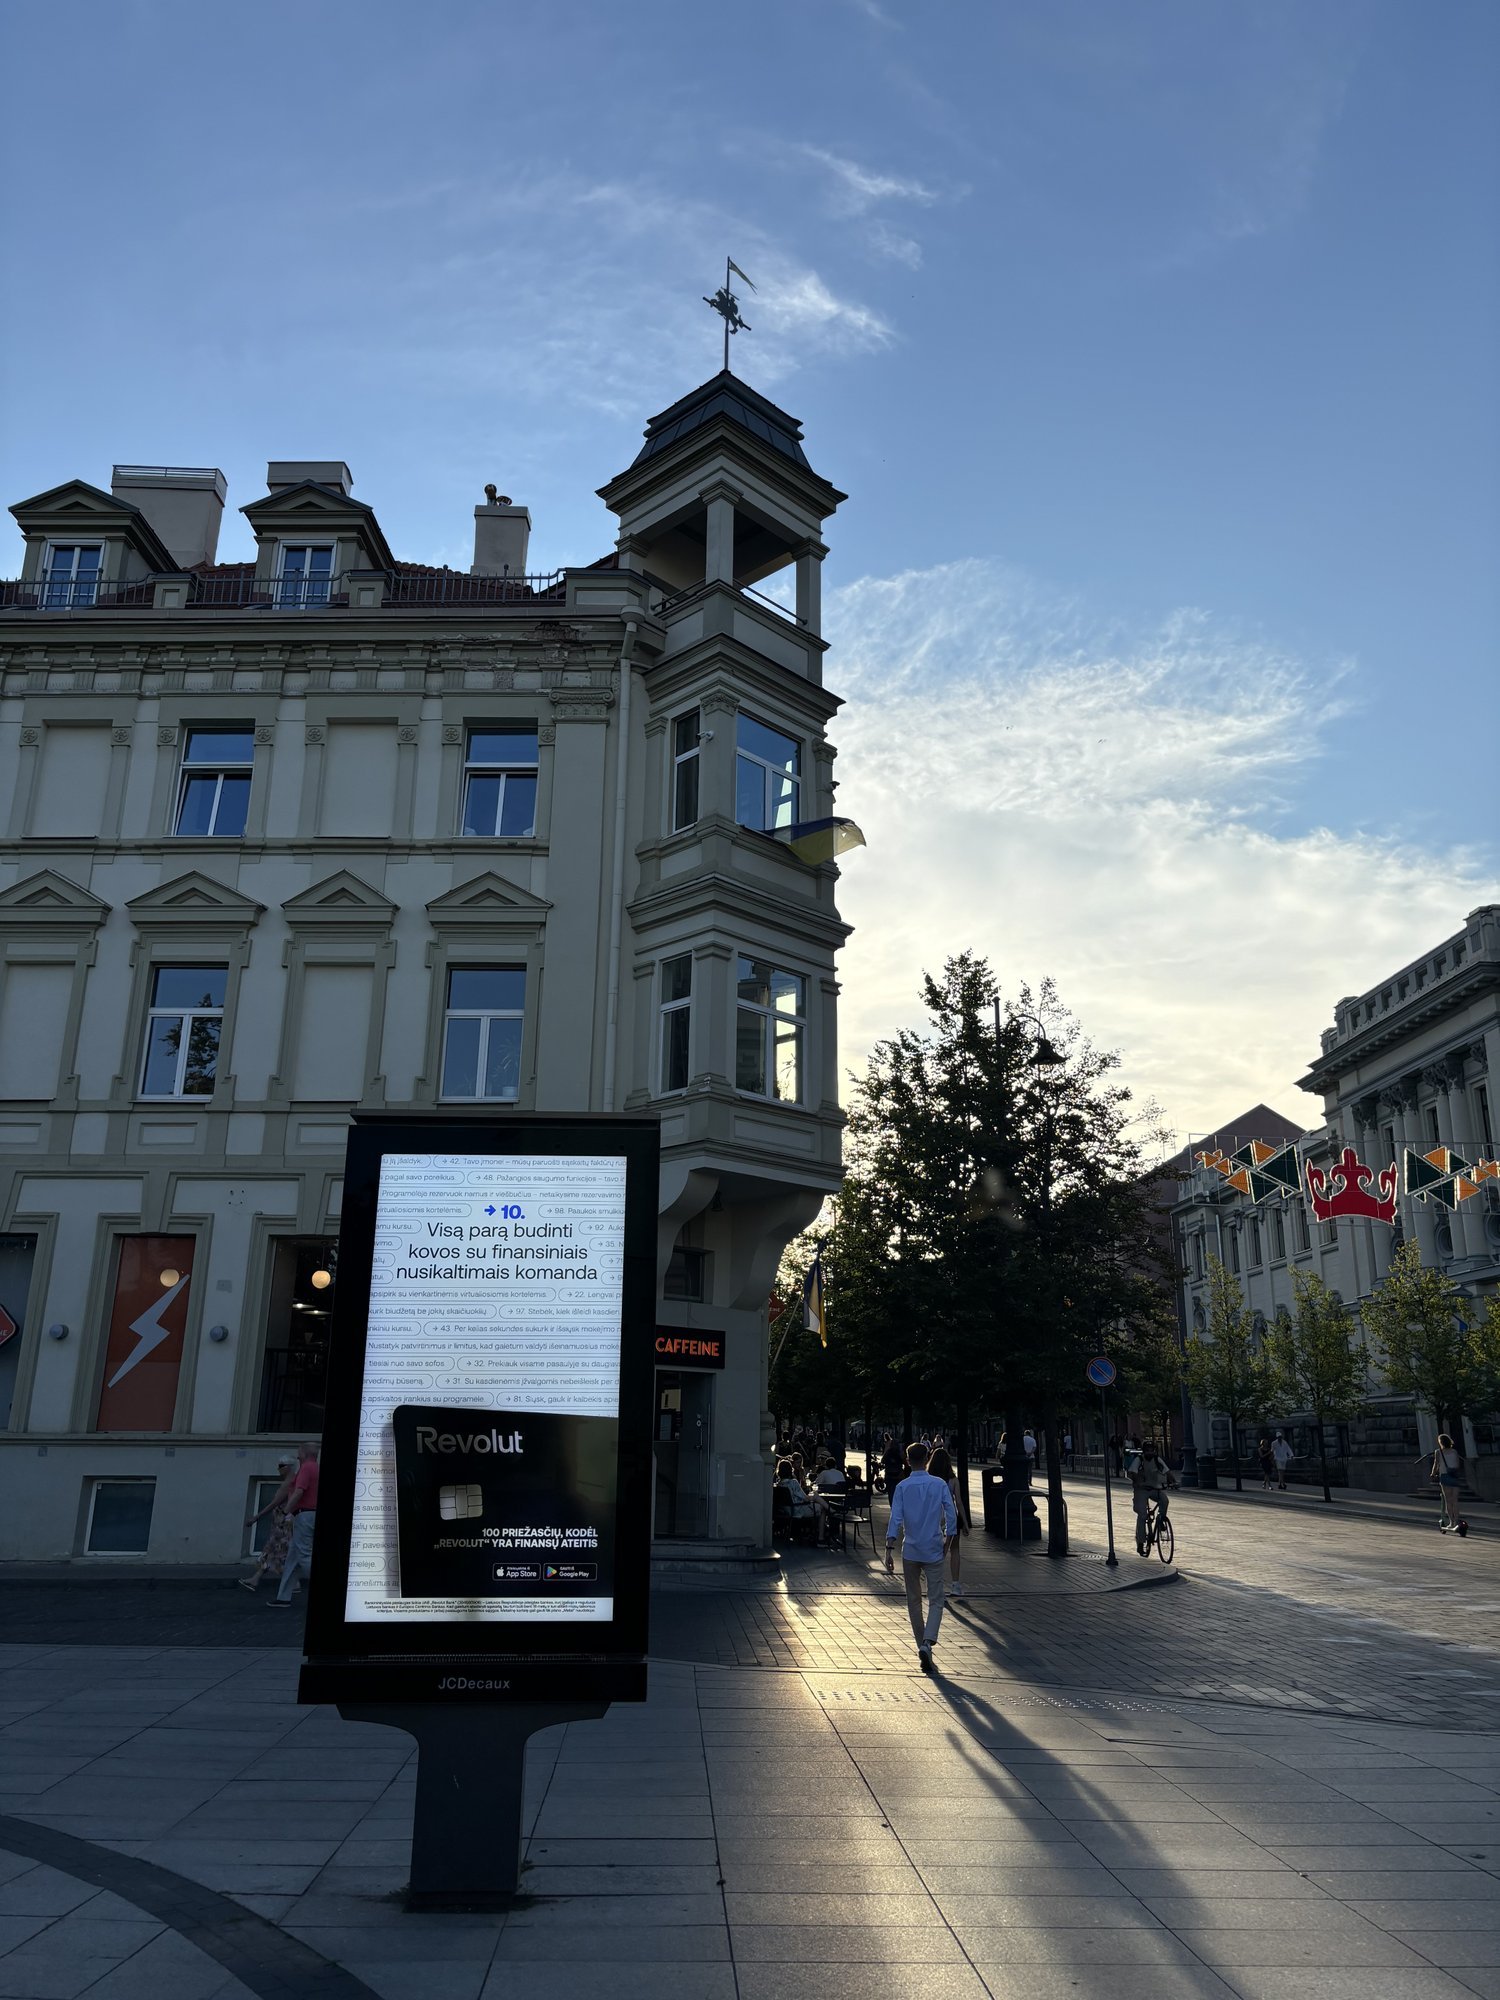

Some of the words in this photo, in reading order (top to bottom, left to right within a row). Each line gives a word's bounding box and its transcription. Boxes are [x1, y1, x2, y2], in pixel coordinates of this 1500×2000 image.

[501, 1205, 526, 1219] 10.
[427, 1222, 463, 1241] Visą
[469, 1226, 508, 1241] parą
[514, 1223, 573, 1238] budinti
[408, 1244, 460, 1259] kovos
[466, 1248, 486, 1259] su
[492, 1244, 588, 1259] finansiniais
[396, 1264, 509, 1279] nusikaltimais
[515, 1264, 598, 1280] komanda
[655, 1337, 720, 1356] CAFFEINE
[416, 1426, 524, 1453] Revolut
[482, 1528, 500, 1537] 100
[502, 1526, 563, 1539] PRIEŽASČIŲ,
[566, 1526, 598, 1537] KODĖL
[492, 1539, 513, 1548] YRA
[515, 1539, 559, 1549] FINANSŲ
[561, 1539, 598, 1548] ATEITIS
[438, 1677, 510, 1689] JCDecaux
